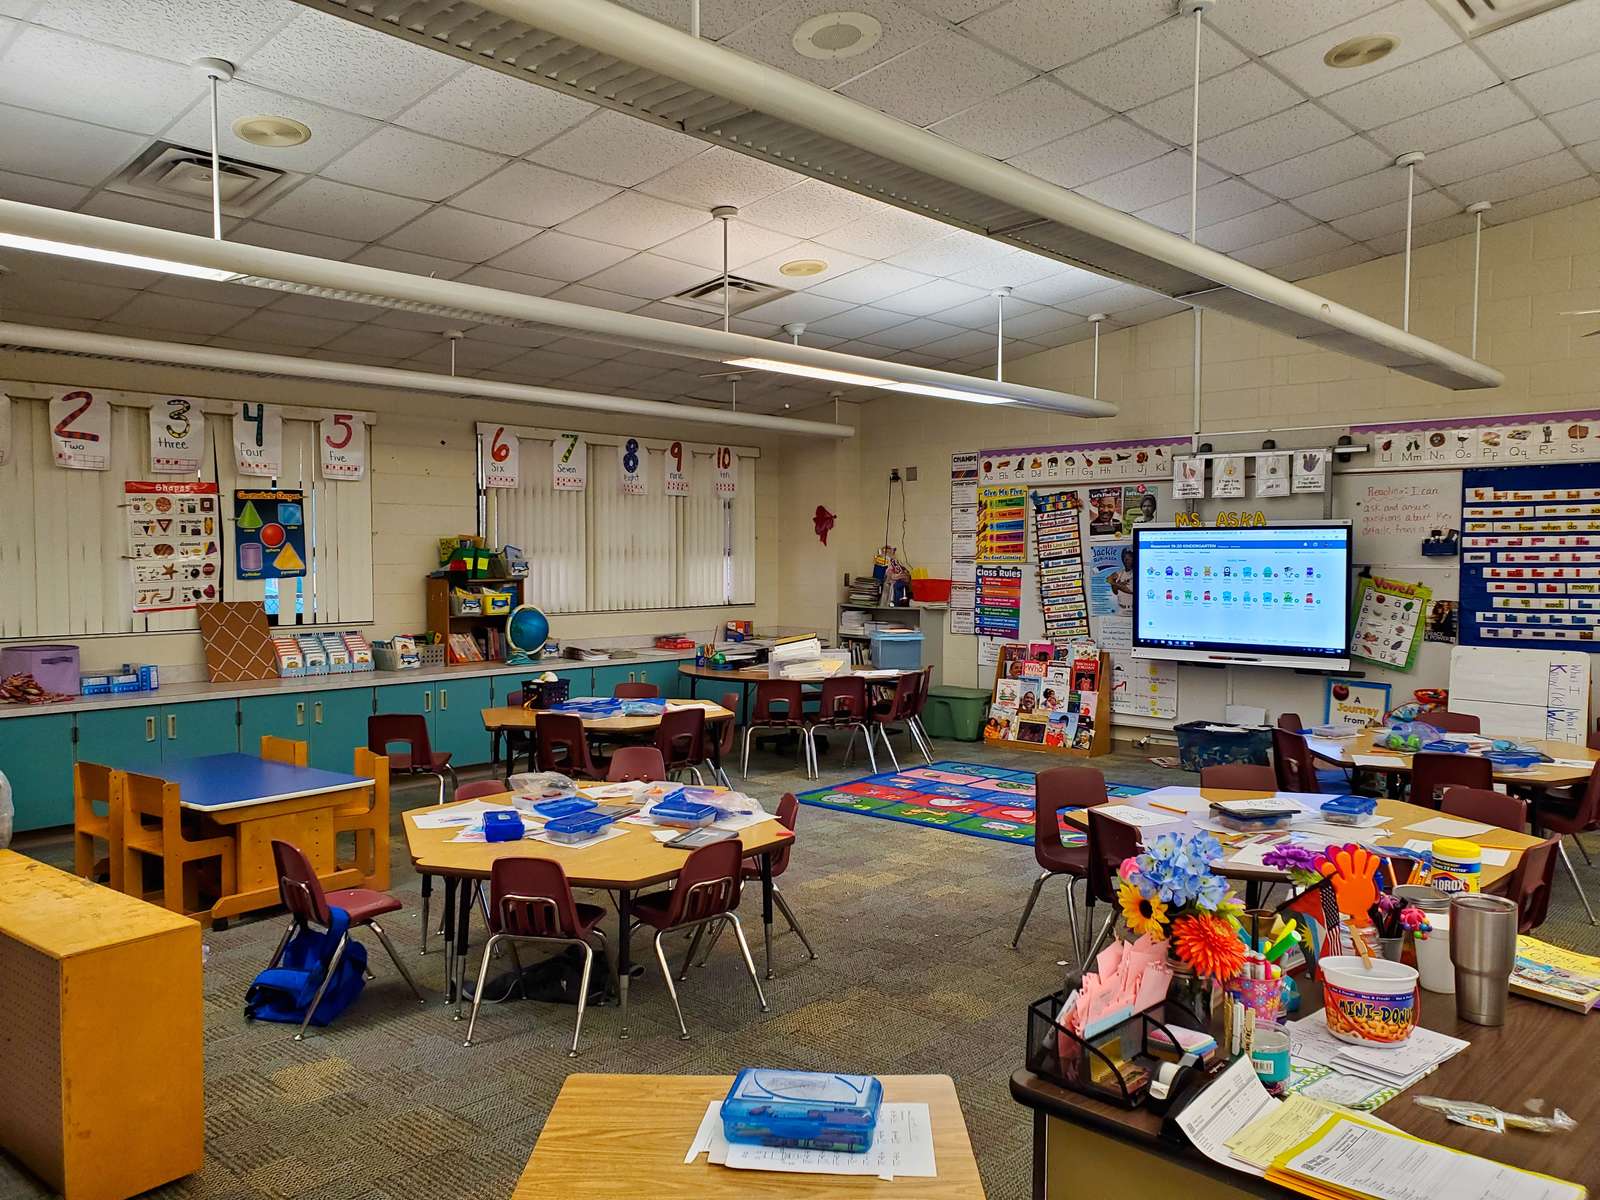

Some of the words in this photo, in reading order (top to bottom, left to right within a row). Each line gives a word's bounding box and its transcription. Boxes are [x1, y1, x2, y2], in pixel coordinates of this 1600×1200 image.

[54, 391, 100, 442] 2
[166, 400, 191, 438] 3
[242, 403, 264, 447] 4
[325, 414, 353, 449] 5
[58, 440, 85, 450] Two
[491, 426, 510, 462] 6
[561, 434, 579, 463] 7
[623, 438, 639, 473] 8
[670, 441, 682, 472] 9
[717, 447, 731, 469] 10
[1401, 452, 1422, 462] Mm
[1429, 451, 1444, 460] Nn
[1455, 450, 1471, 458] Oo
[1483, 448, 1498, 460] Pp
[1509, 447, 1527, 459] Qq
[1539, 446, 1556, 455] Rr
[1569, 444, 1585, 454] Ss
[155, 484, 191, 492] Shapes
[1410, 487, 1419, 496] I
[1175, 512, 1206, 528] MS.
[1216, 512, 1267, 527] ASKA
[1405, 512, 1431, 522] about
[1541, 522, 1561, 531] when
[1092, 548, 1117, 557] Jackie
[977, 568, 997, 577] Class
[999, 570, 1021, 578] Rules
[1374, 577, 1415, 595] Vowels
[1569, 686, 1580, 696] I
[1337, 703, 1378, 717] Journey
[1344, 715, 1365, 724] from
